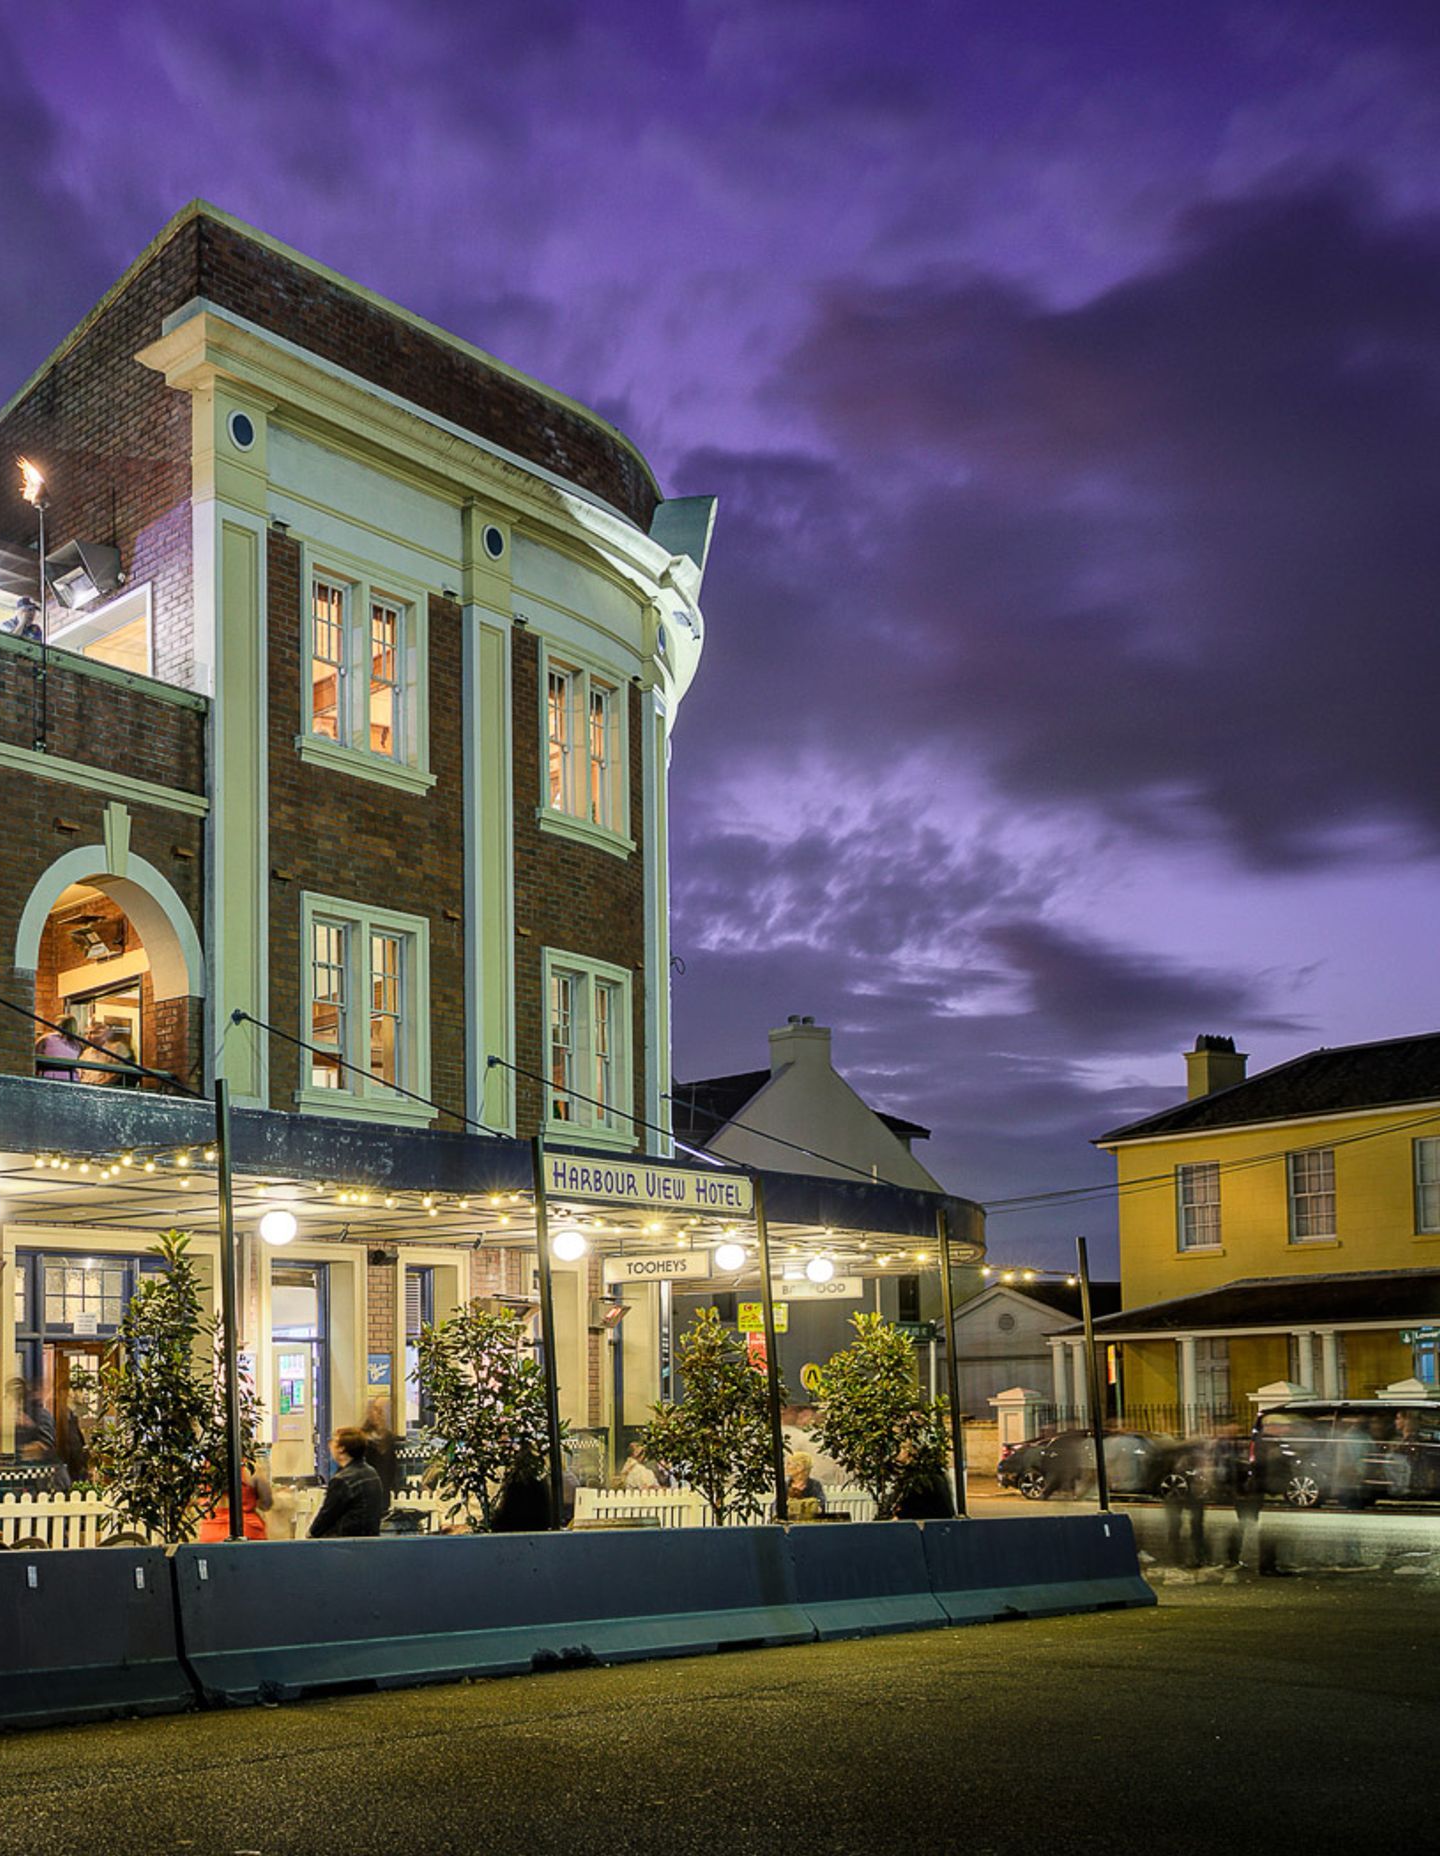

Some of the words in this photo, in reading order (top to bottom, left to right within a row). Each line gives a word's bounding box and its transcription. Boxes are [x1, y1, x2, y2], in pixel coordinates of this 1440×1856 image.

[553, 1160, 639, 1196] HARBOUR
[645, 1171, 686, 1201] VIEW
[695, 1177, 742, 1207] HOTEL
[626, 1258, 687, 1275] TOOHEYS
[814, 1283, 846, 1294] OOD
